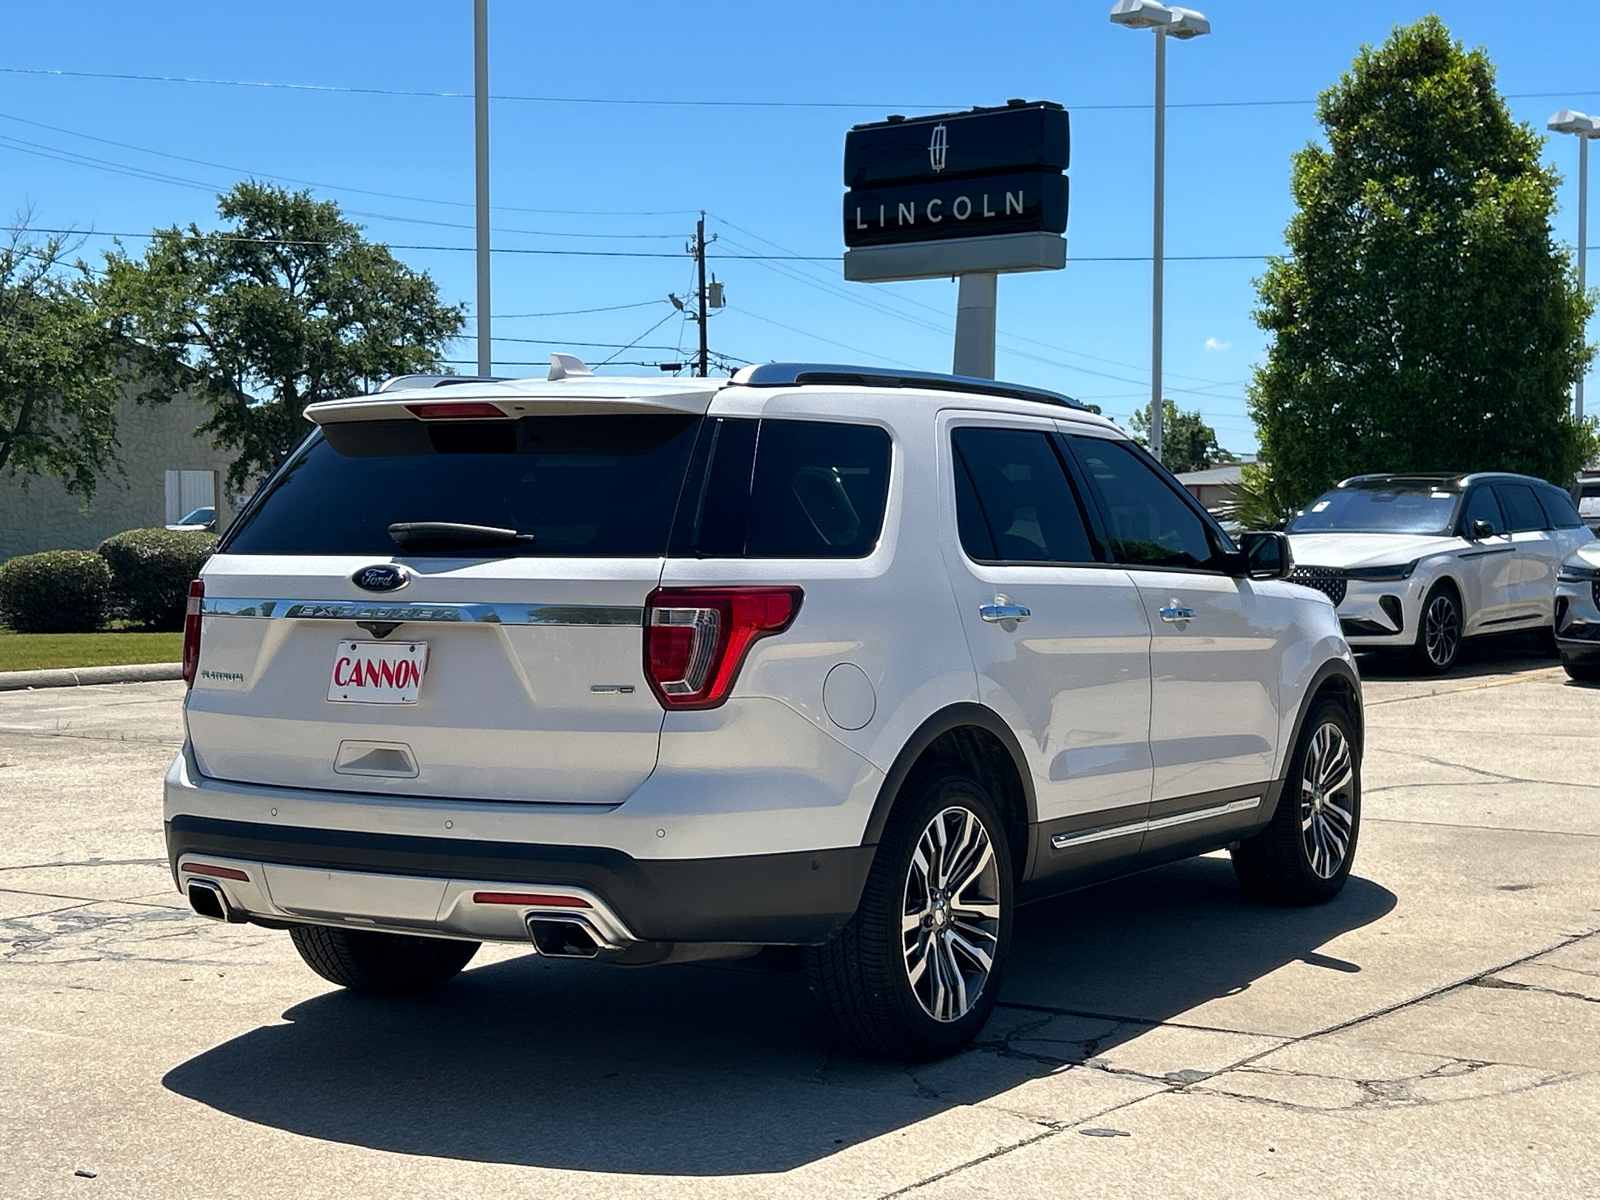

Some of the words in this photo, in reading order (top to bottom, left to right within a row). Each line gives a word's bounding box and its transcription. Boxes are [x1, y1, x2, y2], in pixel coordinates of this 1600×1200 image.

[856, 190, 1024, 229] LINCOLN
[361, 568, 394, 586] Ford
[297, 604, 461, 620] EXPLORER
[334, 656, 422, 688] CANNON
